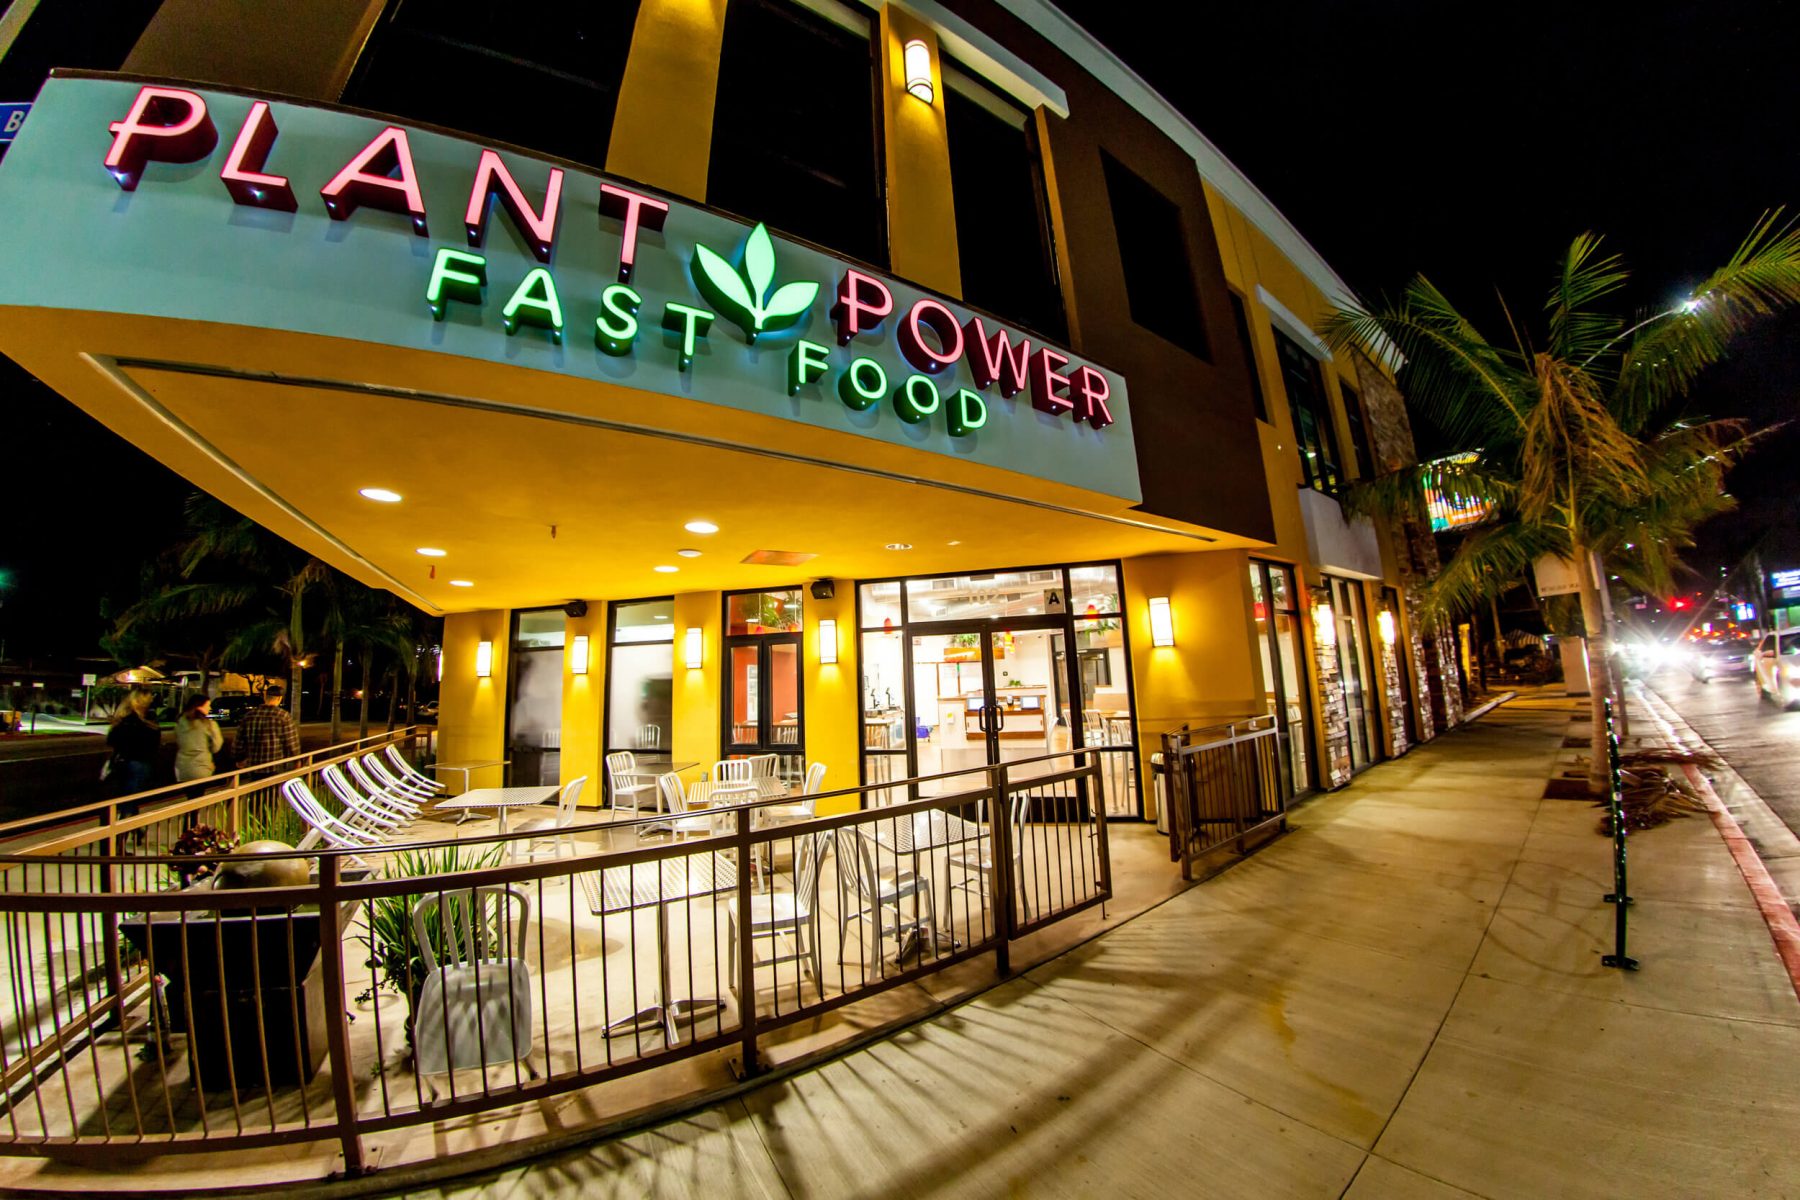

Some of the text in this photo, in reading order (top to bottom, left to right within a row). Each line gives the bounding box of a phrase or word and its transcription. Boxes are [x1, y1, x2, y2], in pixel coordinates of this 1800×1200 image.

[104, 85, 1115, 427] PLANT POWER
[425, 247, 989, 432] FAST FOOD
[1048, 591, 1060, 605] A
